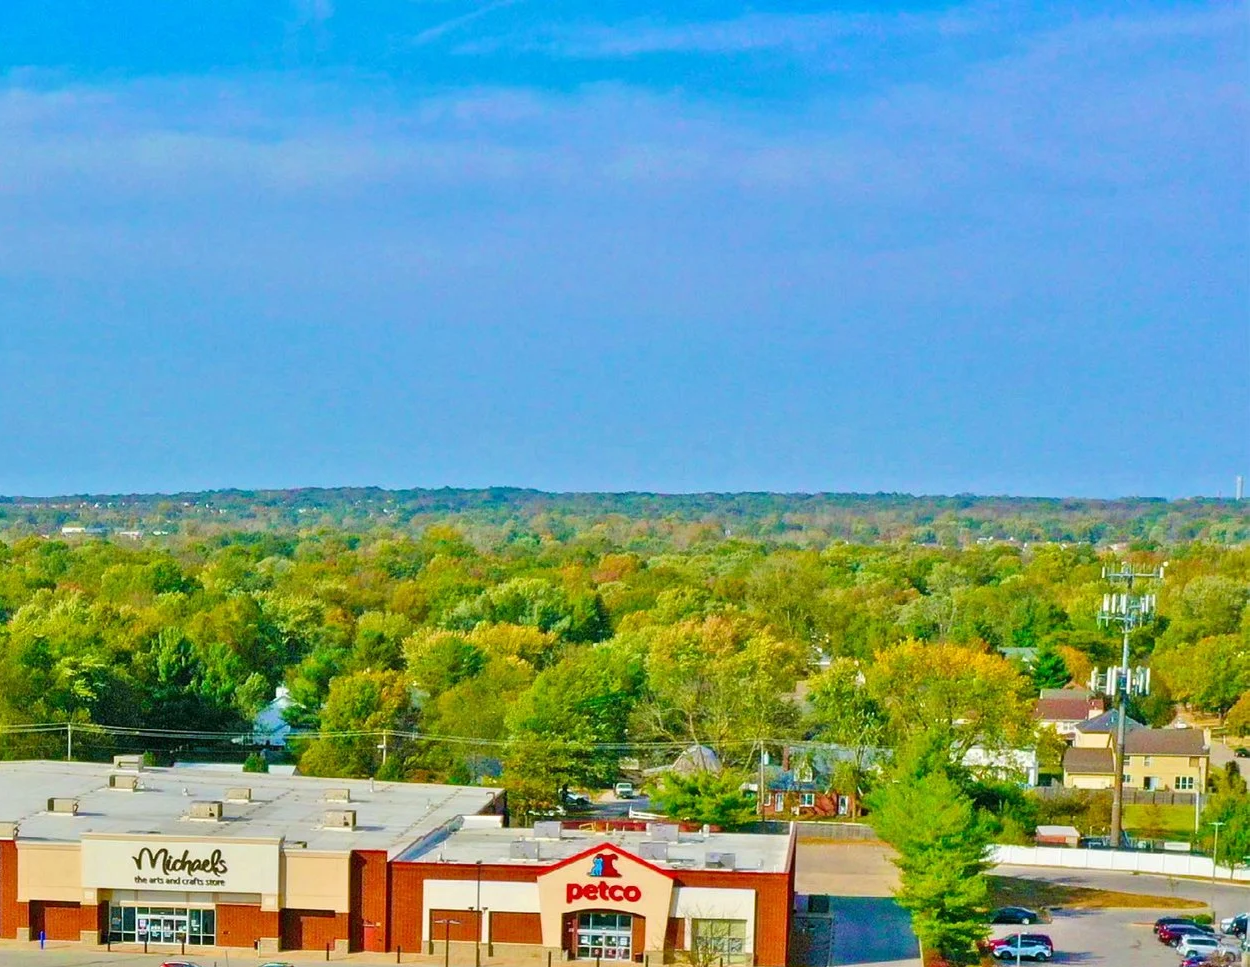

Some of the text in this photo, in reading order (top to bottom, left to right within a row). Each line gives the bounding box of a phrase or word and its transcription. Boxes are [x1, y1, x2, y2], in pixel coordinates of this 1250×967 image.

[132, 847, 228, 877] Michaels
[134, 876, 225, 887] the arts and crafts store
[566, 881, 641, 904] petco
